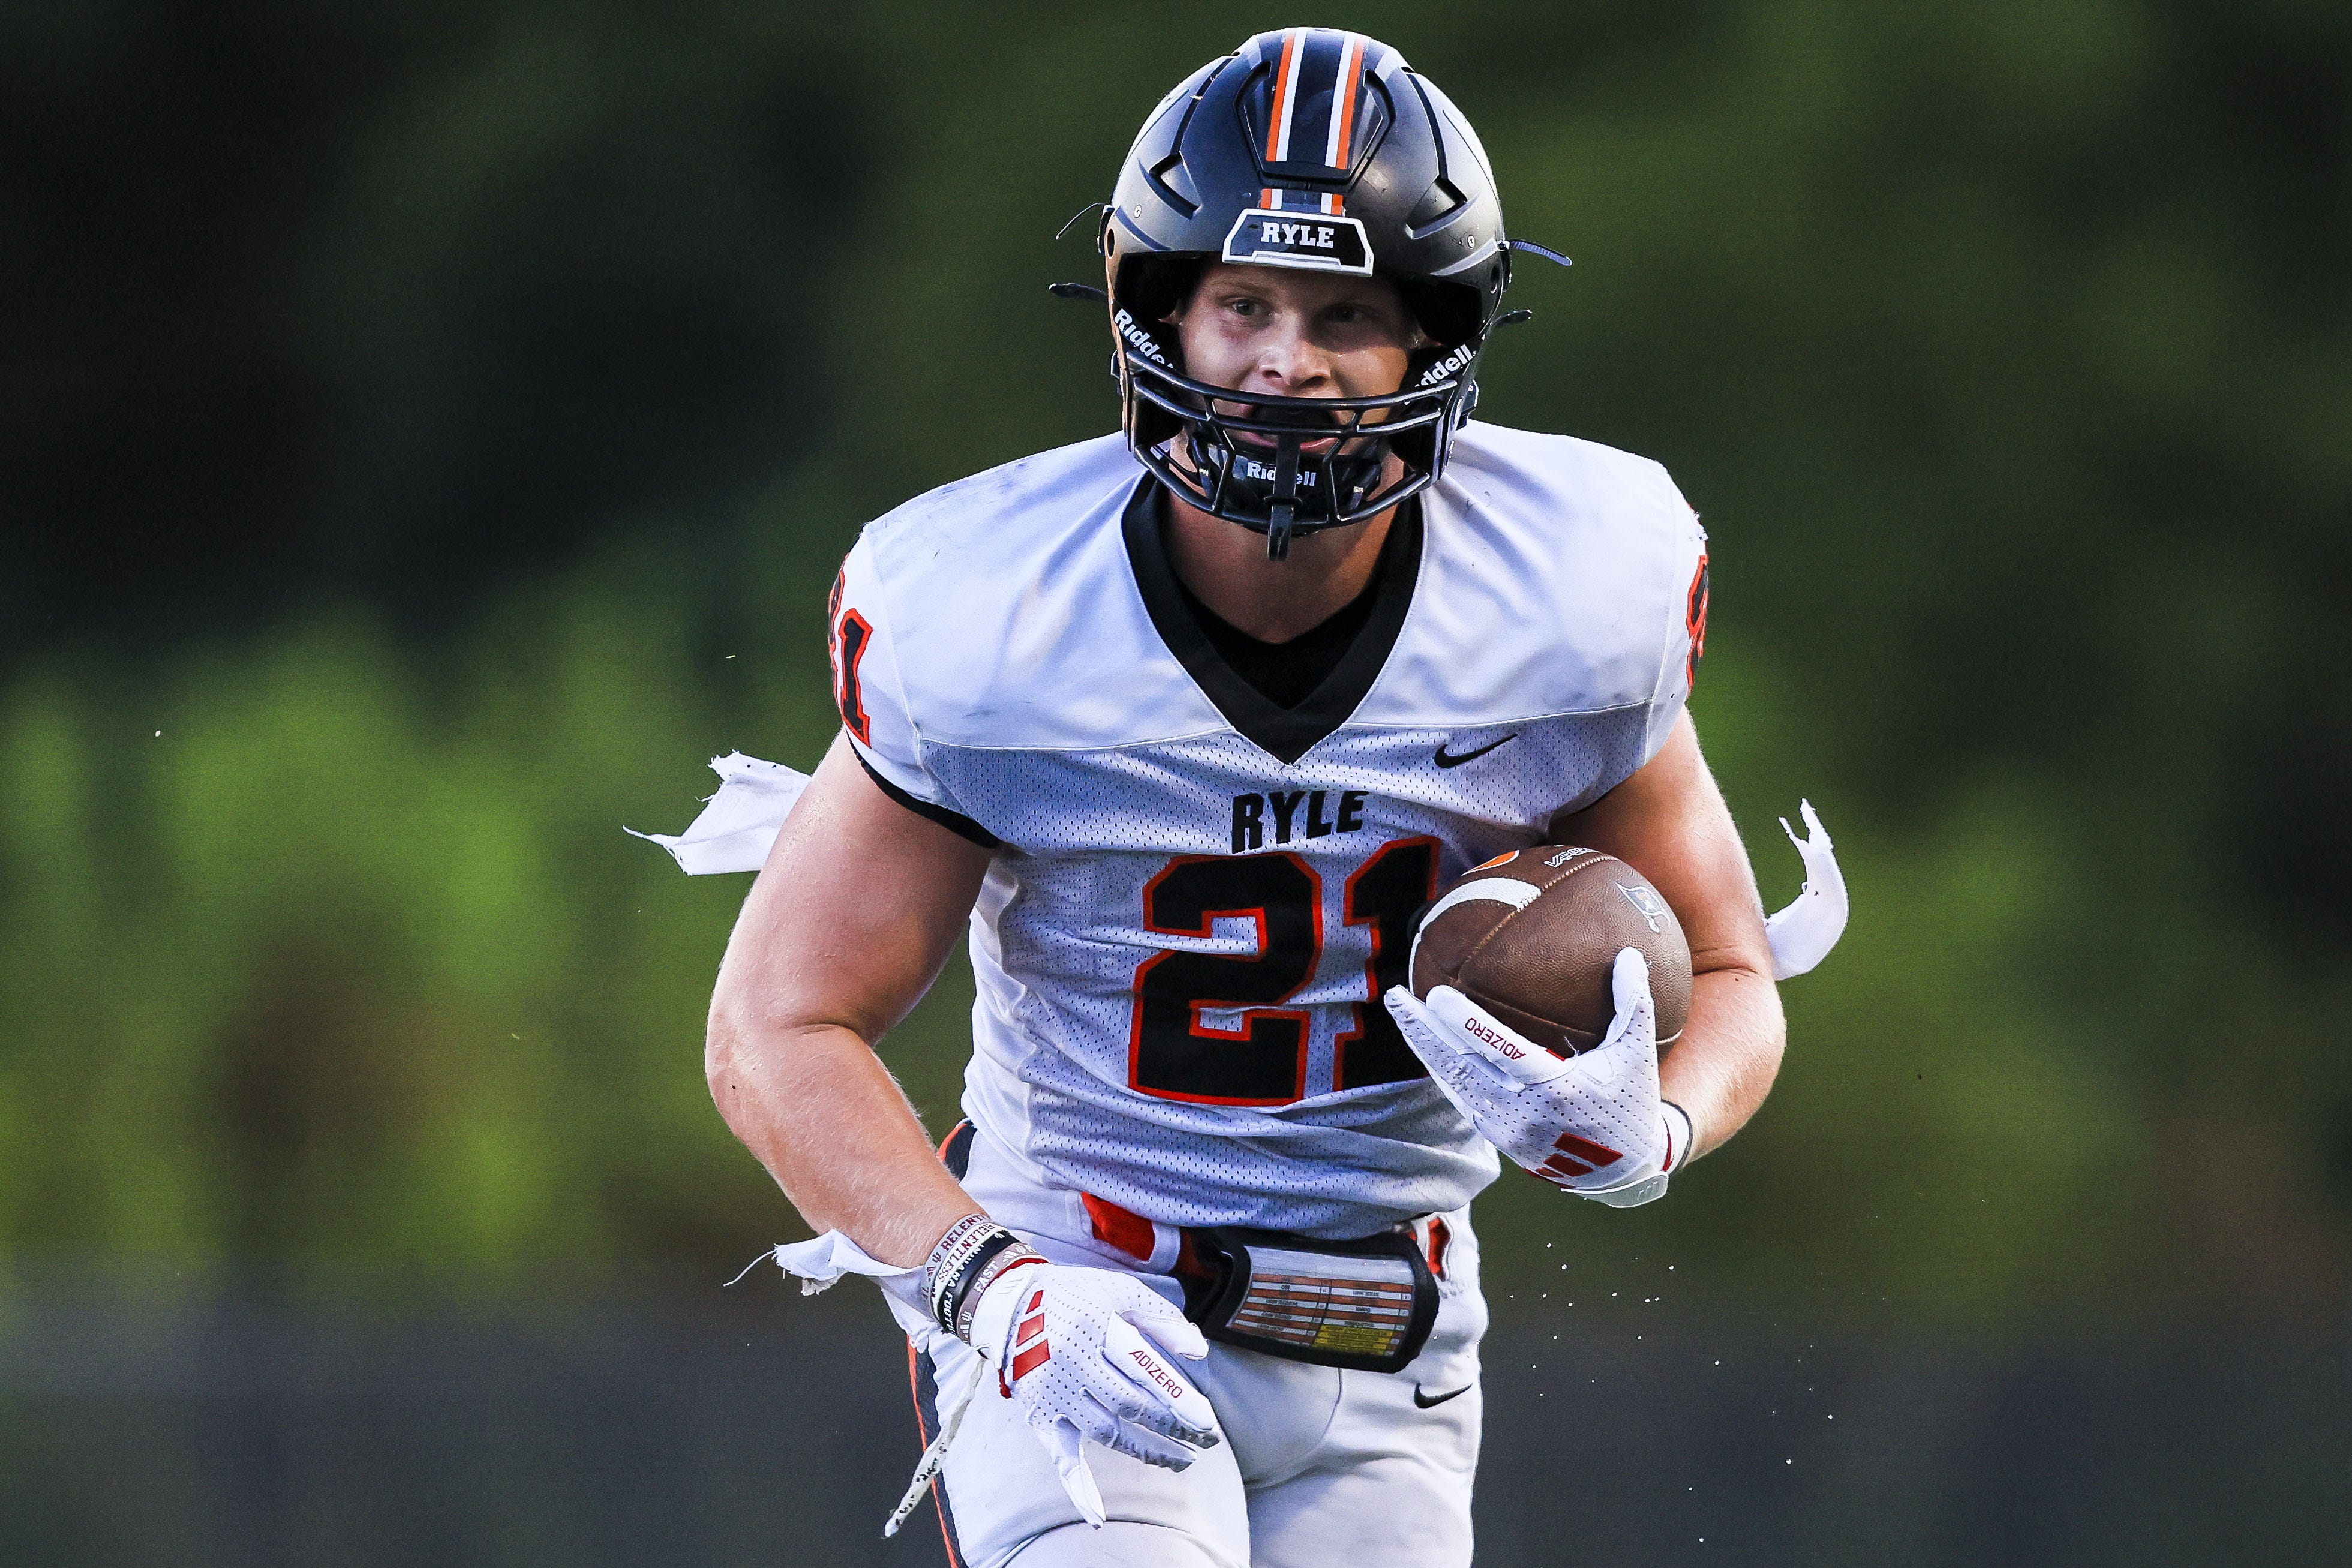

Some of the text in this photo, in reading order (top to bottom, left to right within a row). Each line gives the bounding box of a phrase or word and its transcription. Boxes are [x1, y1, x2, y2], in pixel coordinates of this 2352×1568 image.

[1260, 221, 1335, 248] RYLE
[1114, 308, 1174, 368] Ridde
[1414, 344, 1473, 387] ddell
[1247, 462, 1317, 486] Ridell
[1231, 790, 1369, 854] RYLE
[1127, 835, 1441, 1107] 21
[1465, 1017, 1527, 1061] ADIZERO
[938, 1223, 996, 1283] RELENTLESS
[974, 1260, 999, 1294] FAST
[1128, 1350, 1183, 1399] ADIZERO
